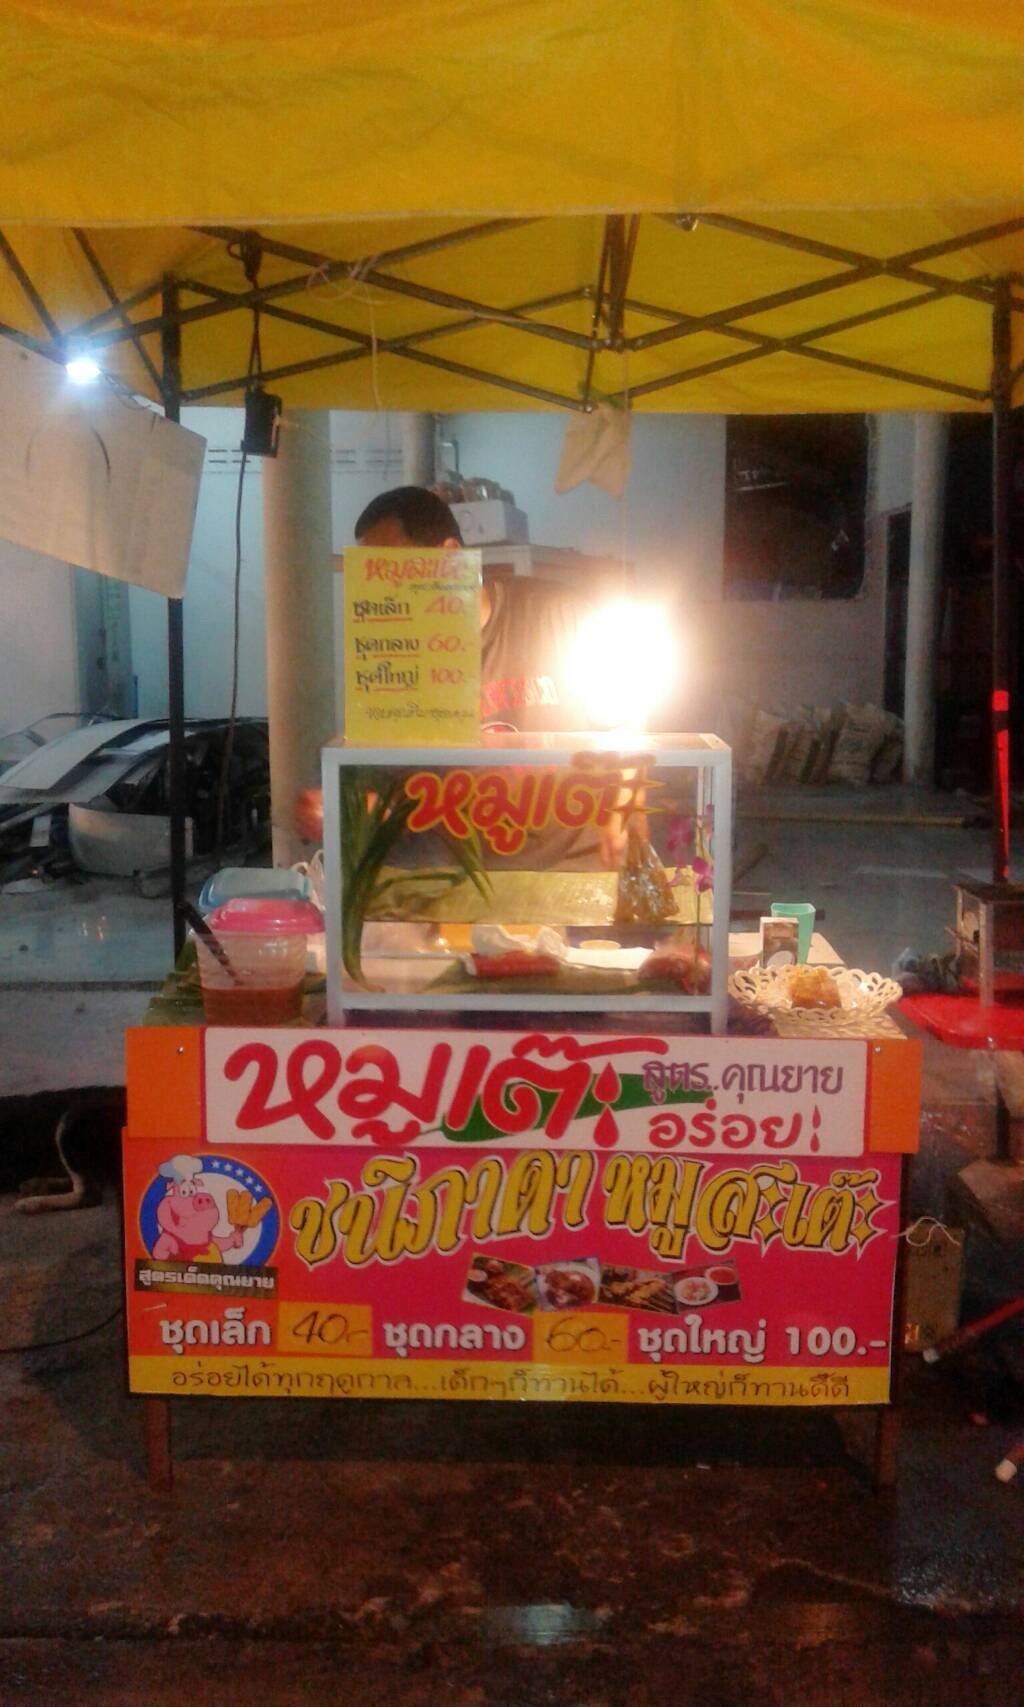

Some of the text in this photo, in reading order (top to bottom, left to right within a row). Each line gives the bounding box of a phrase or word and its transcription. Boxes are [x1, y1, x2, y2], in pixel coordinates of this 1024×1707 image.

[159, 1306, 272, 1356] ชุดเล็ก
[382, 1322, 526, 1358] ชุดกลาง
[637, 1314, 767, 1364] ชุดใหญ่
[785, 1325, 887, 1357] 100.-
